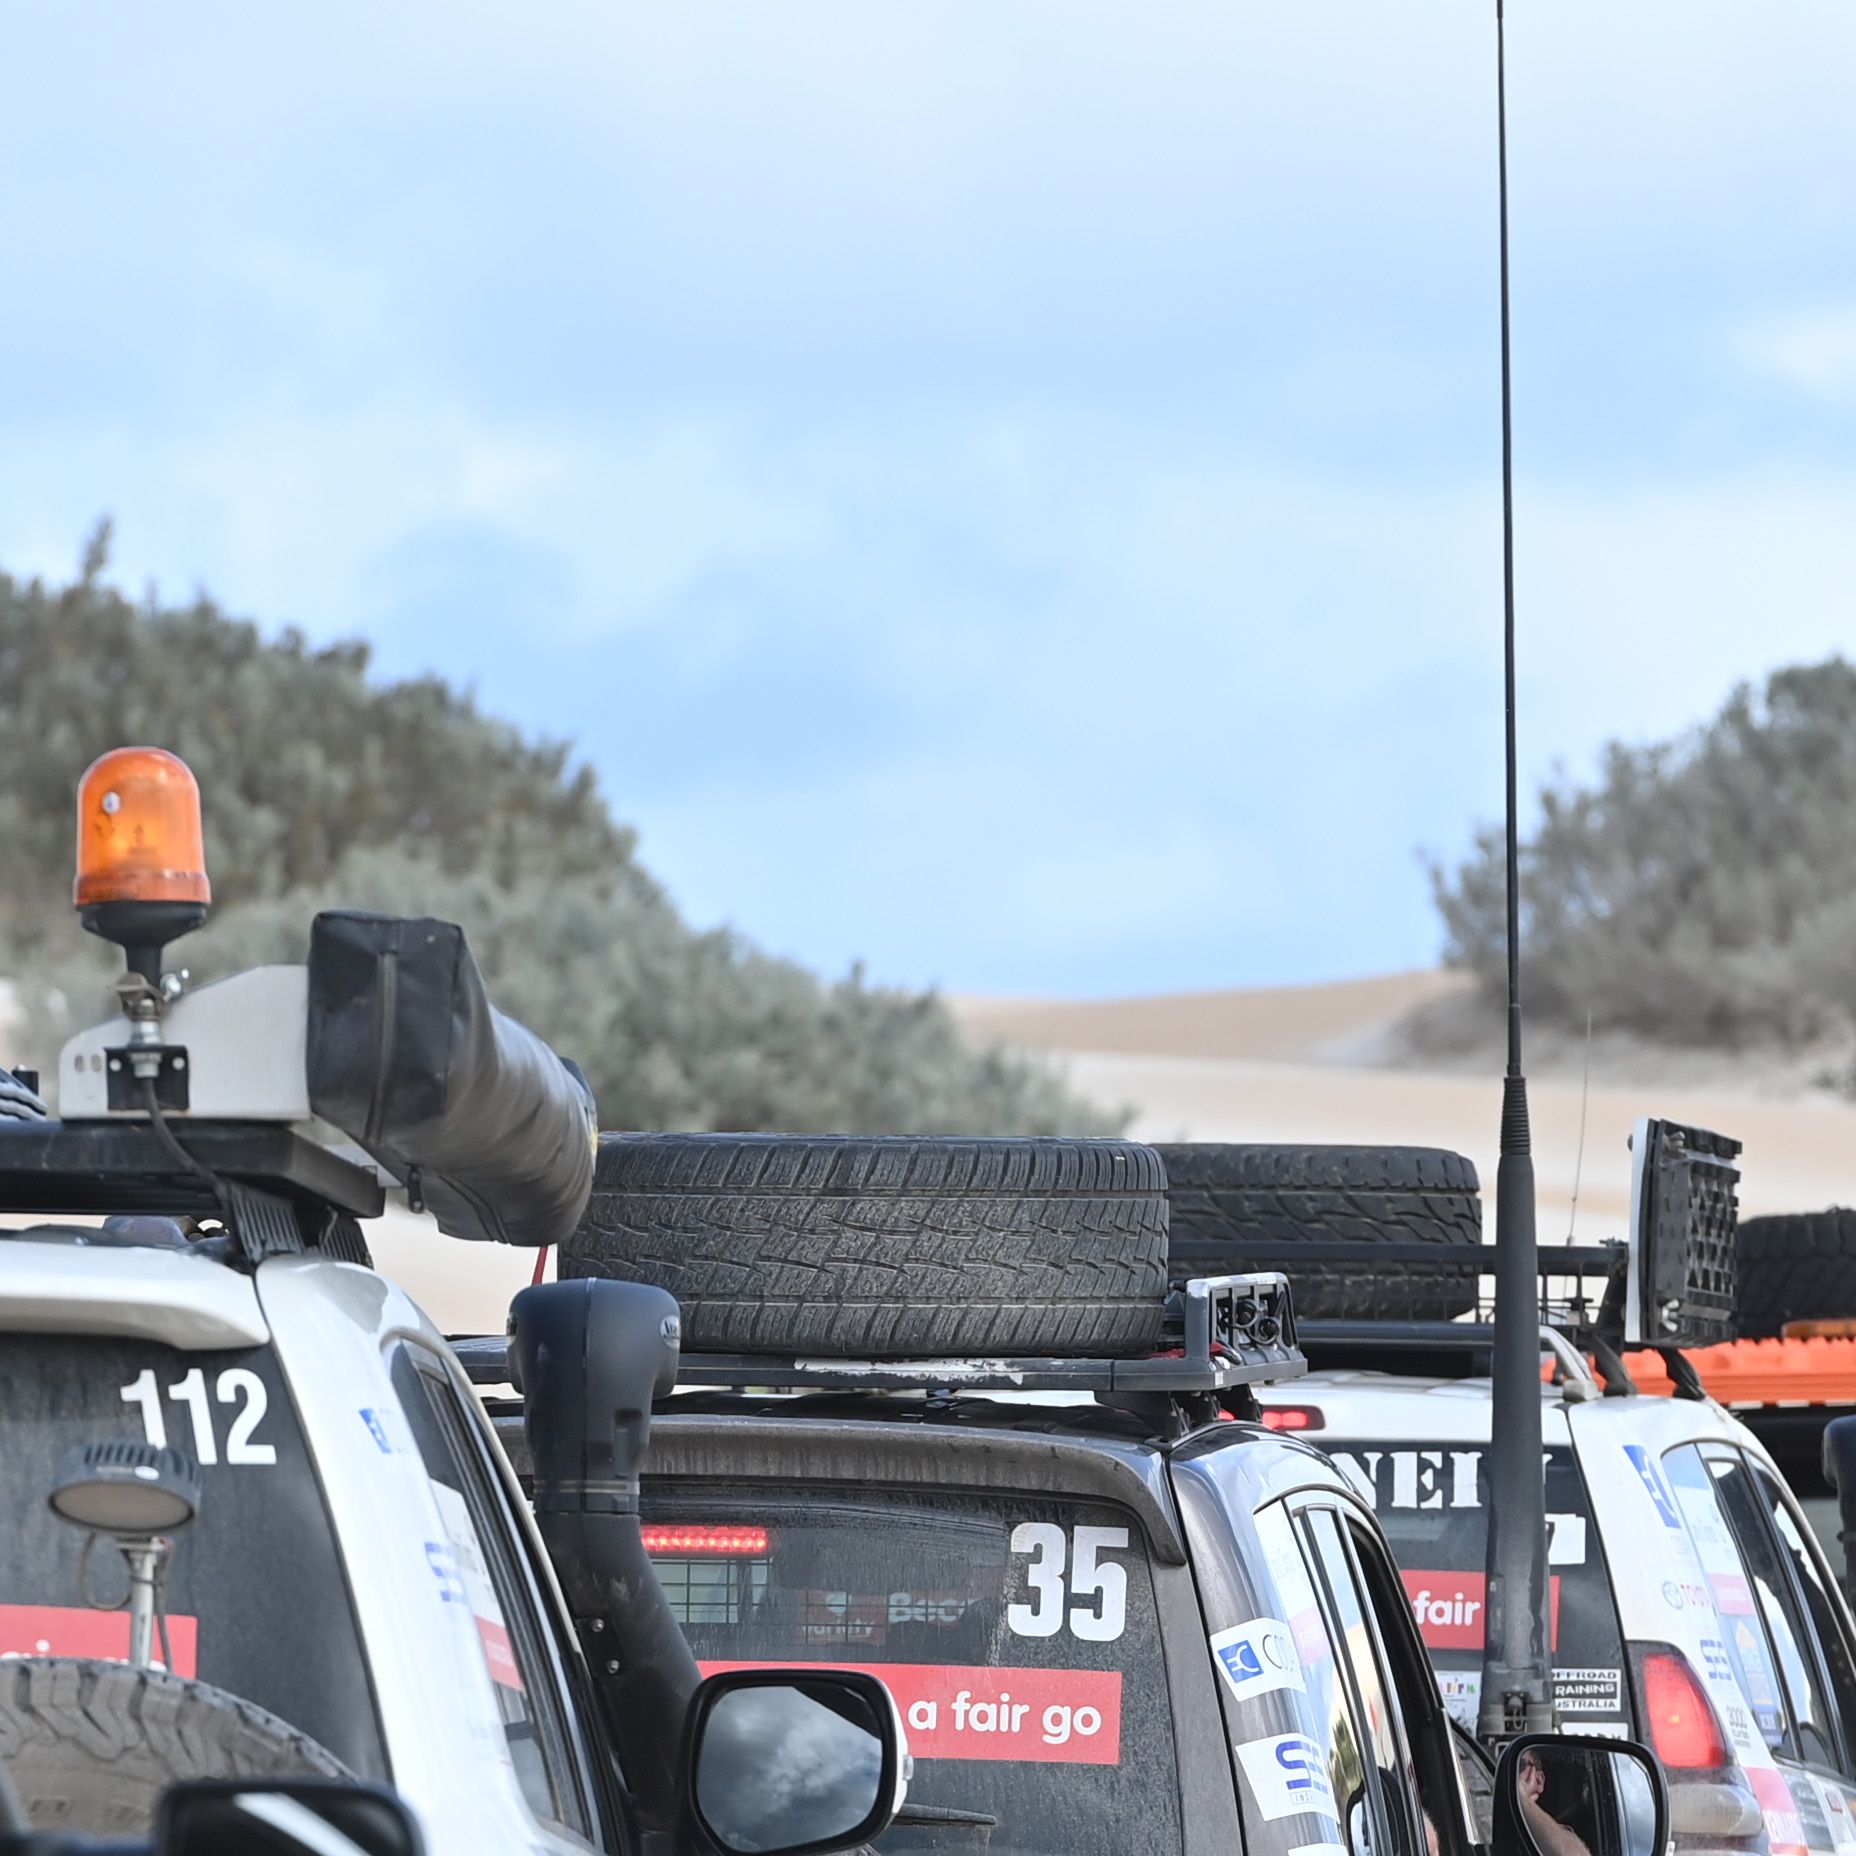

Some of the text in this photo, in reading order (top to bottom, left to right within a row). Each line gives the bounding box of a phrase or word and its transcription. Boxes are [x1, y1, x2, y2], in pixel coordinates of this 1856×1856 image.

[119, 1367, 277, 1465] 112
[1007, 1521, 1130, 1642] 35
[1412, 1589, 1482, 1626] fair
[907, 1690, 1103, 1745] a fair go
[1555, 1683, 1615, 1697] RAINING
